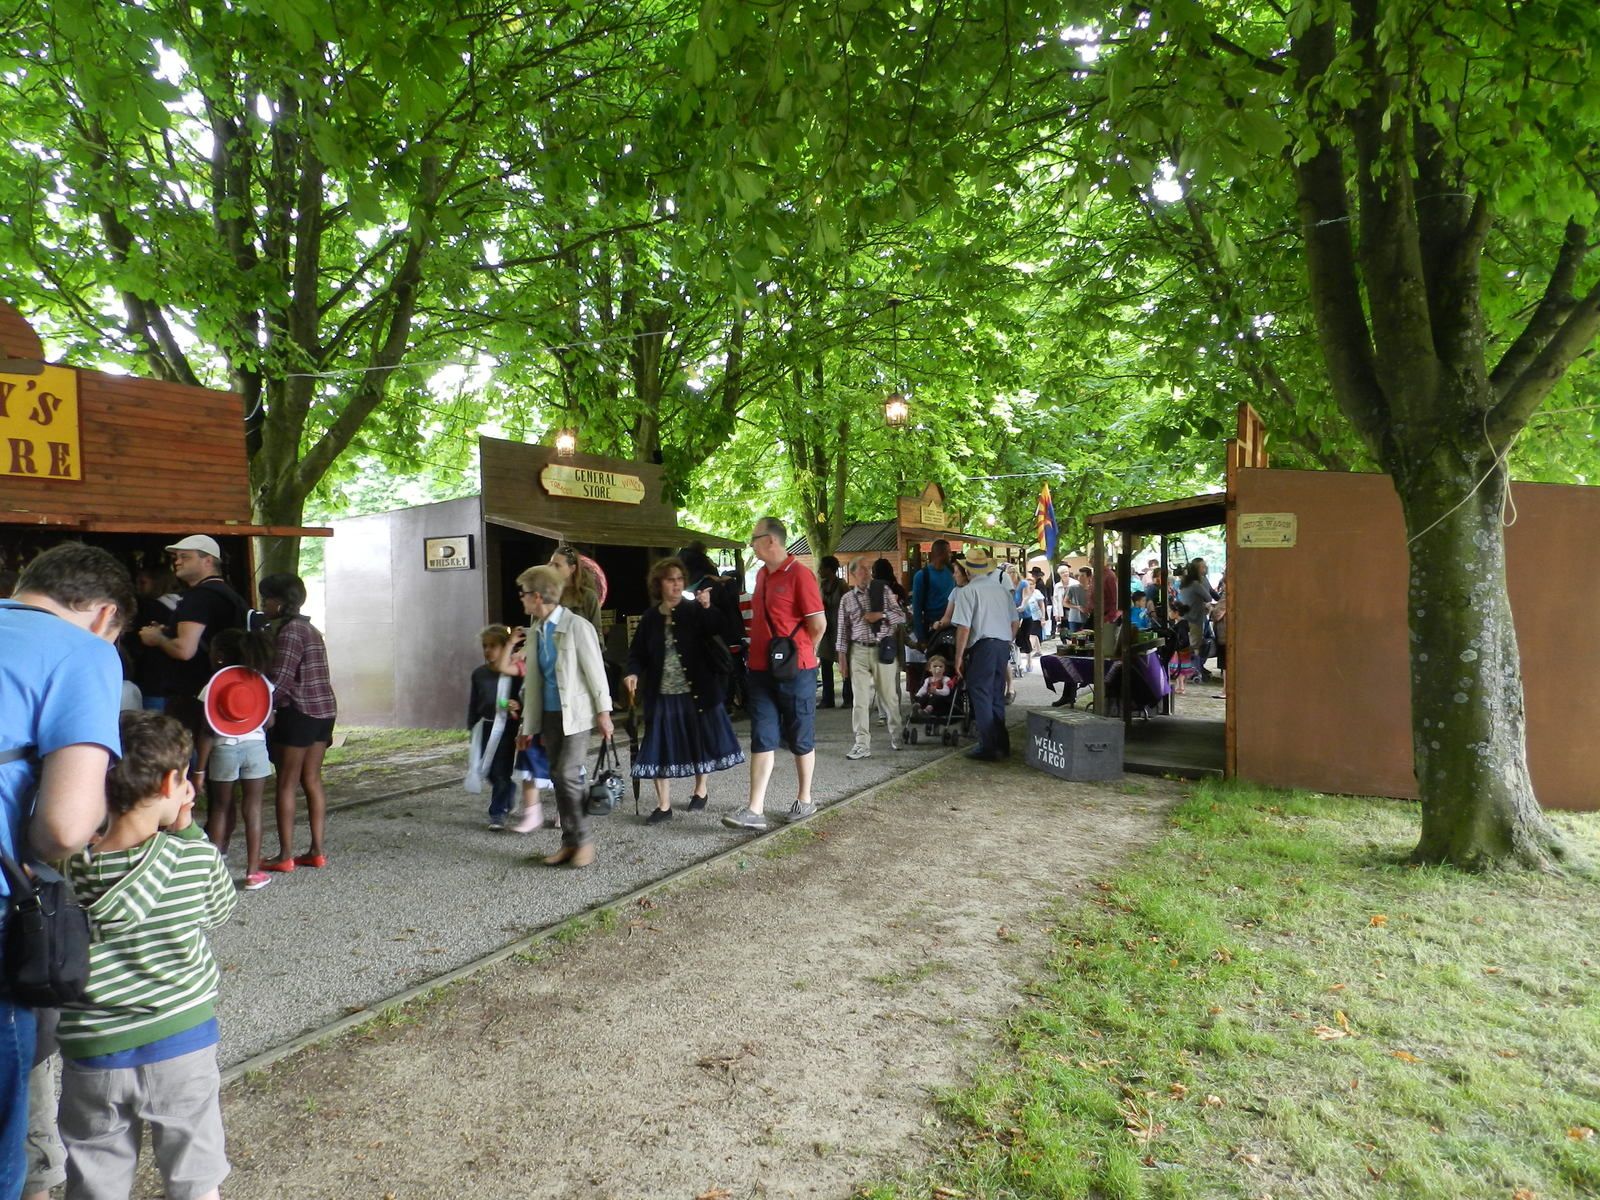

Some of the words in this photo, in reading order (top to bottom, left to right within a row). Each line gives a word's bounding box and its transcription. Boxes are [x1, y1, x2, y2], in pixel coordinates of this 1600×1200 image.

[575, 469, 617, 487] GENERAL
[583, 484, 612, 500] STORE
[429, 557, 467, 568] WHISKEY
[1034, 735, 1064, 756] WELLS
[1038, 748, 1066, 769] FARGO
